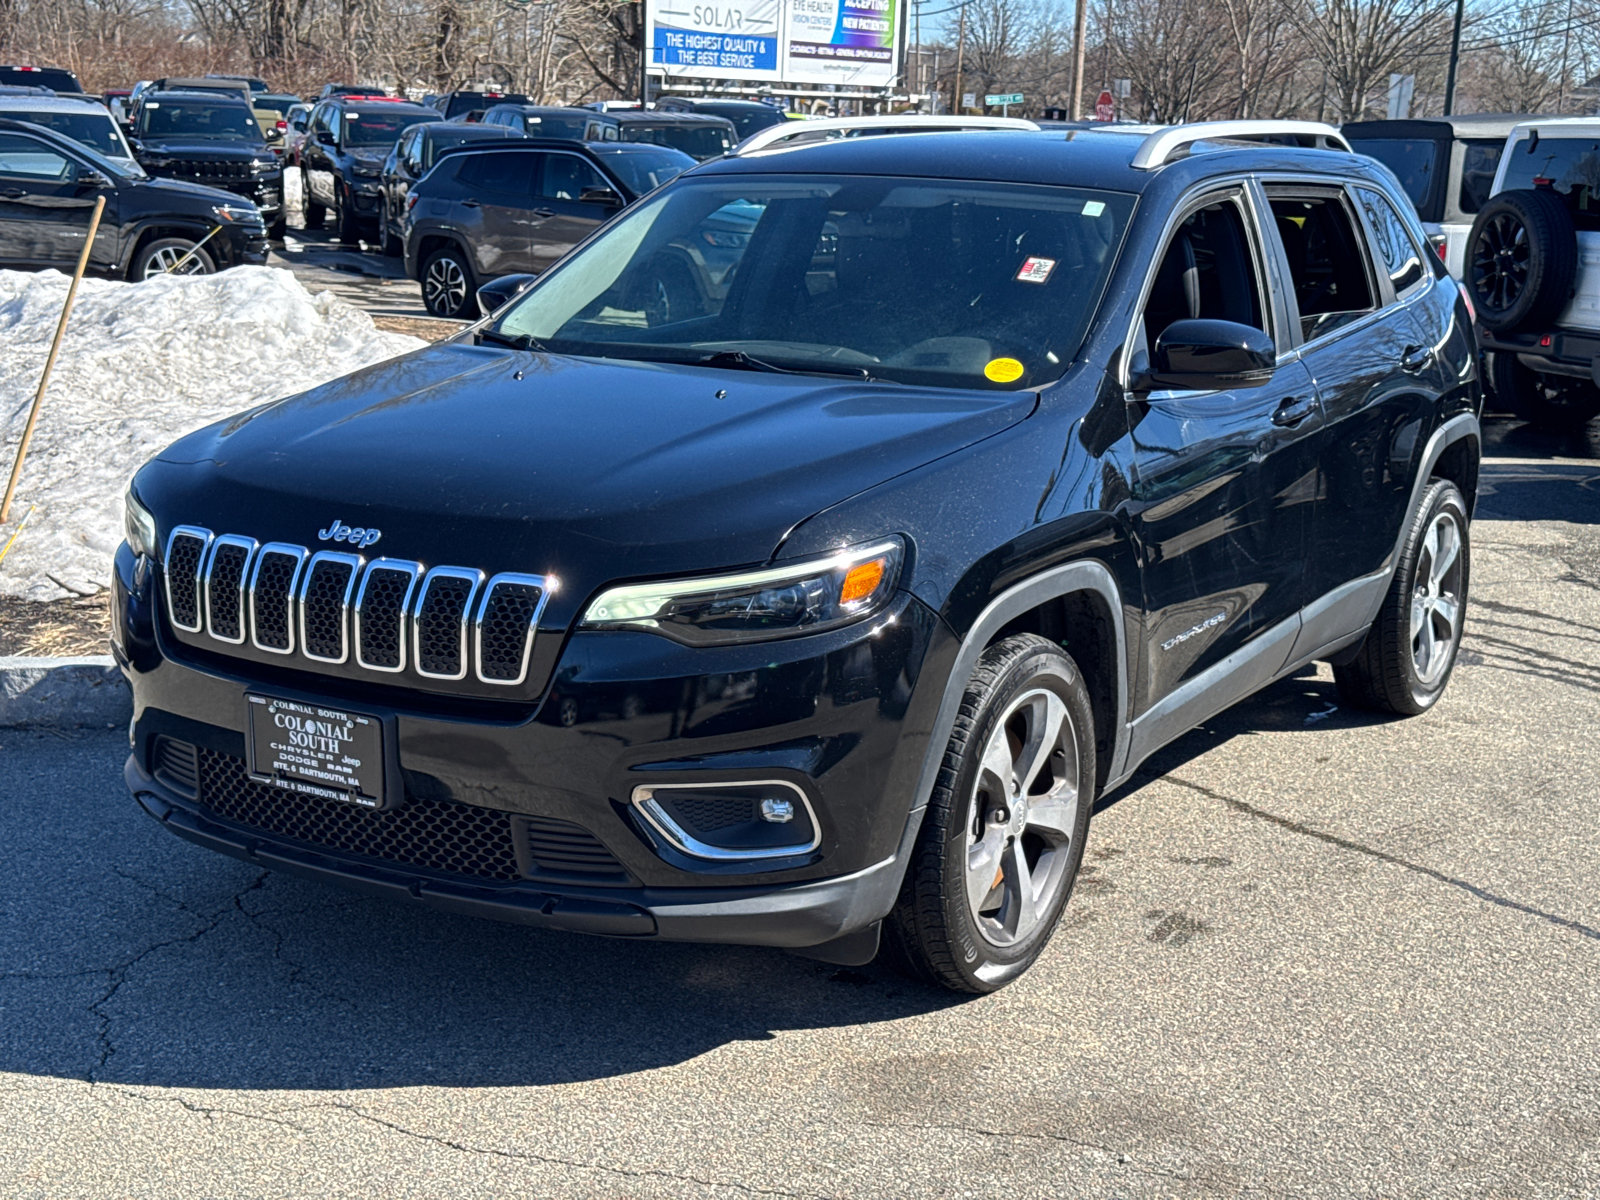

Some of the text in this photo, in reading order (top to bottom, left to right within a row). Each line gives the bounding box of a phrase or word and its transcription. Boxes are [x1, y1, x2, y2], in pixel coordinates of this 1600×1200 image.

[693, 5, 742, 29] SOLAR
[807, 0, 833, 13] HEALTH
[844, 0, 890, 11] ACCEPTING
[842, 17, 858, 29] NEW
[665, 32, 766, 54] THE HIGHEST QUALITY &
[677, 49, 755, 68] THE BEST SERVICE
[318, 519, 382, 549] Jeep
[273, 700, 315, 715] COLONIAL
[317, 709, 348, 721] SOUTH
[274, 713, 353, 742] COLONIAL
[288, 730, 340, 754] SOUTH
[269, 742, 361, 767] CHRYSLER Jeep
[278, 752, 353, 775] DODGE RAM
[273, 760, 360, 787] RTE. 6 DARTMOUTH, MA
[275, 779, 350, 803] RTE. 6 DARTMOUTH, MA
